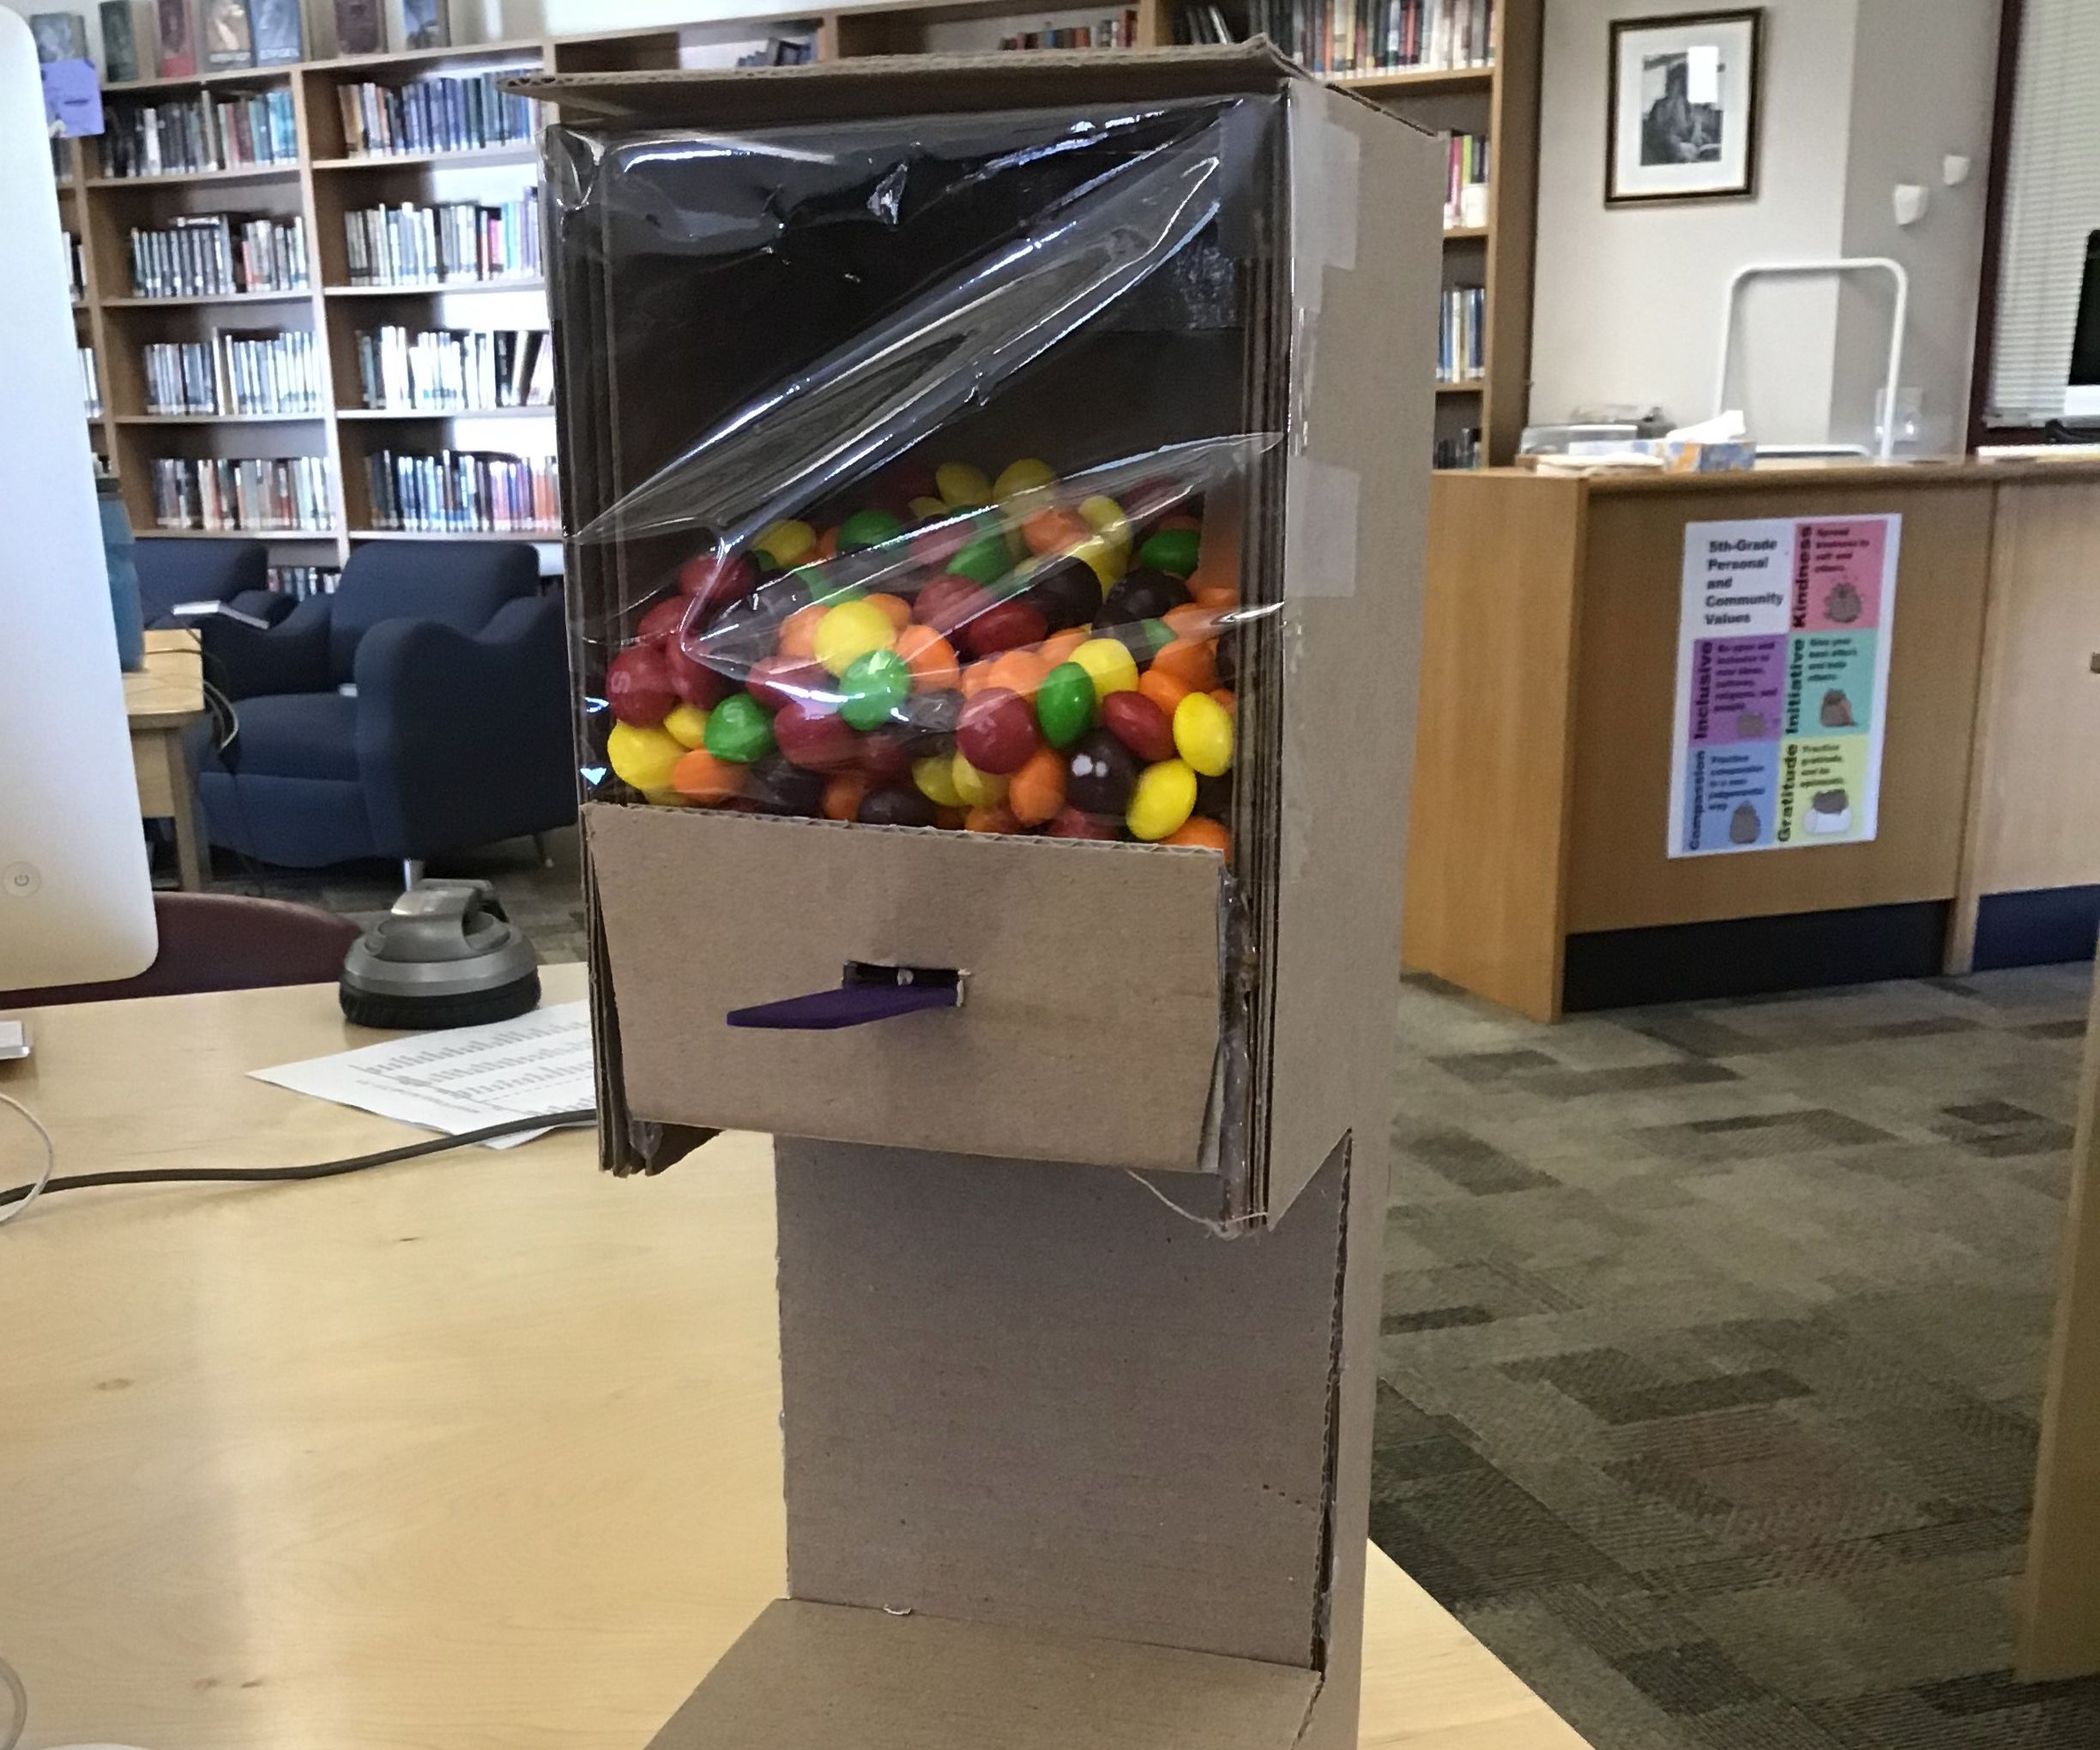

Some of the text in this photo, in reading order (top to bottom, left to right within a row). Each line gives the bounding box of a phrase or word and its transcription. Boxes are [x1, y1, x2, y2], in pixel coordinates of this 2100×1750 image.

[1707, 557, 1769, 571] Personal
[1709, 539, 1778, 553] 5th-Grade
[1705, 593, 1784, 608] Community
[1706, 576, 1733, 590] and
[1792, 526, 1811, 628] Kindness
[1705, 614, 1751, 625] Values
[1693, 641, 1712, 739] Inclusive
[1785, 639, 1804, 734] Initiative
[1689, 750, 1705, 850] Compassion
[1777, 744, 1798, 842] Gratitude
